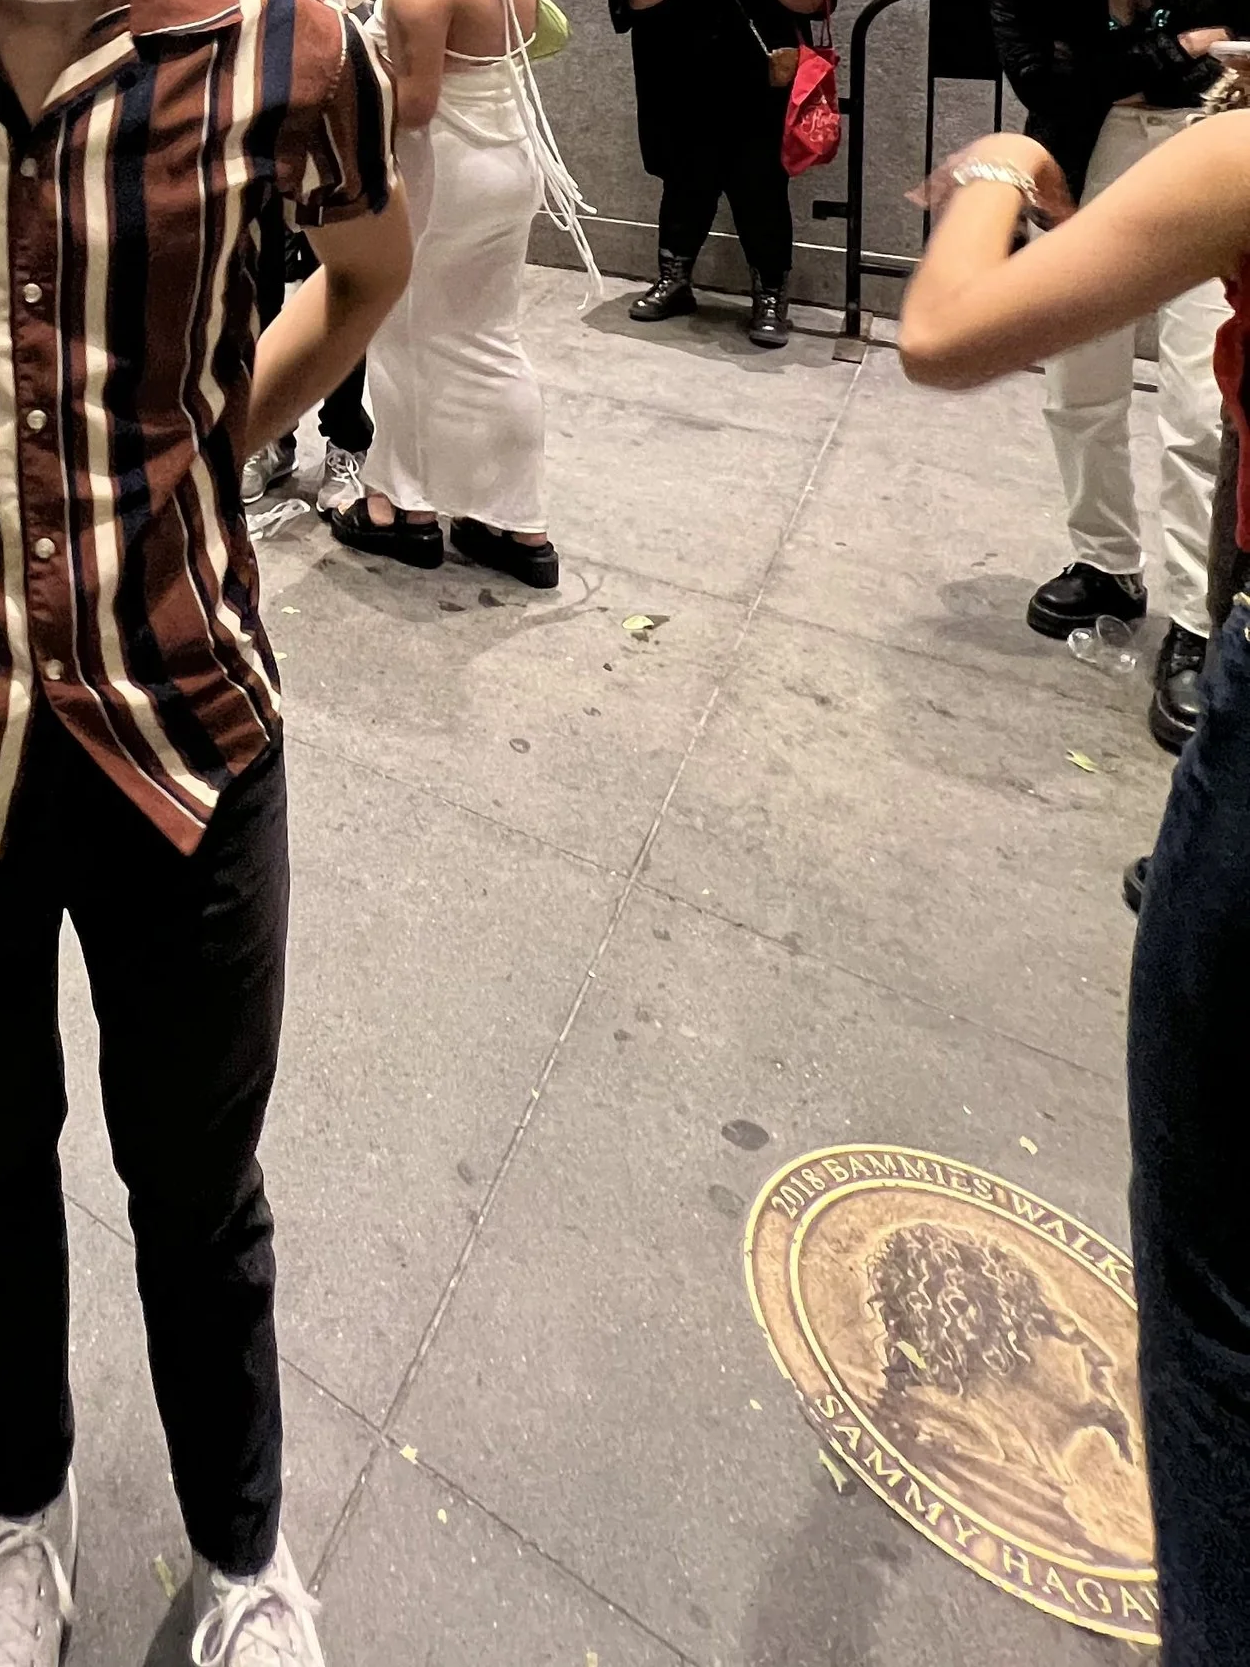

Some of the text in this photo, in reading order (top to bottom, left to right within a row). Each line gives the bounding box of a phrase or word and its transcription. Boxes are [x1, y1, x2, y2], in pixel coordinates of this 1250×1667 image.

[770, 1153, 1132, 1286] 2018 BAMMIES WALK
[814, 1393, 982, 1549] SAMMY
